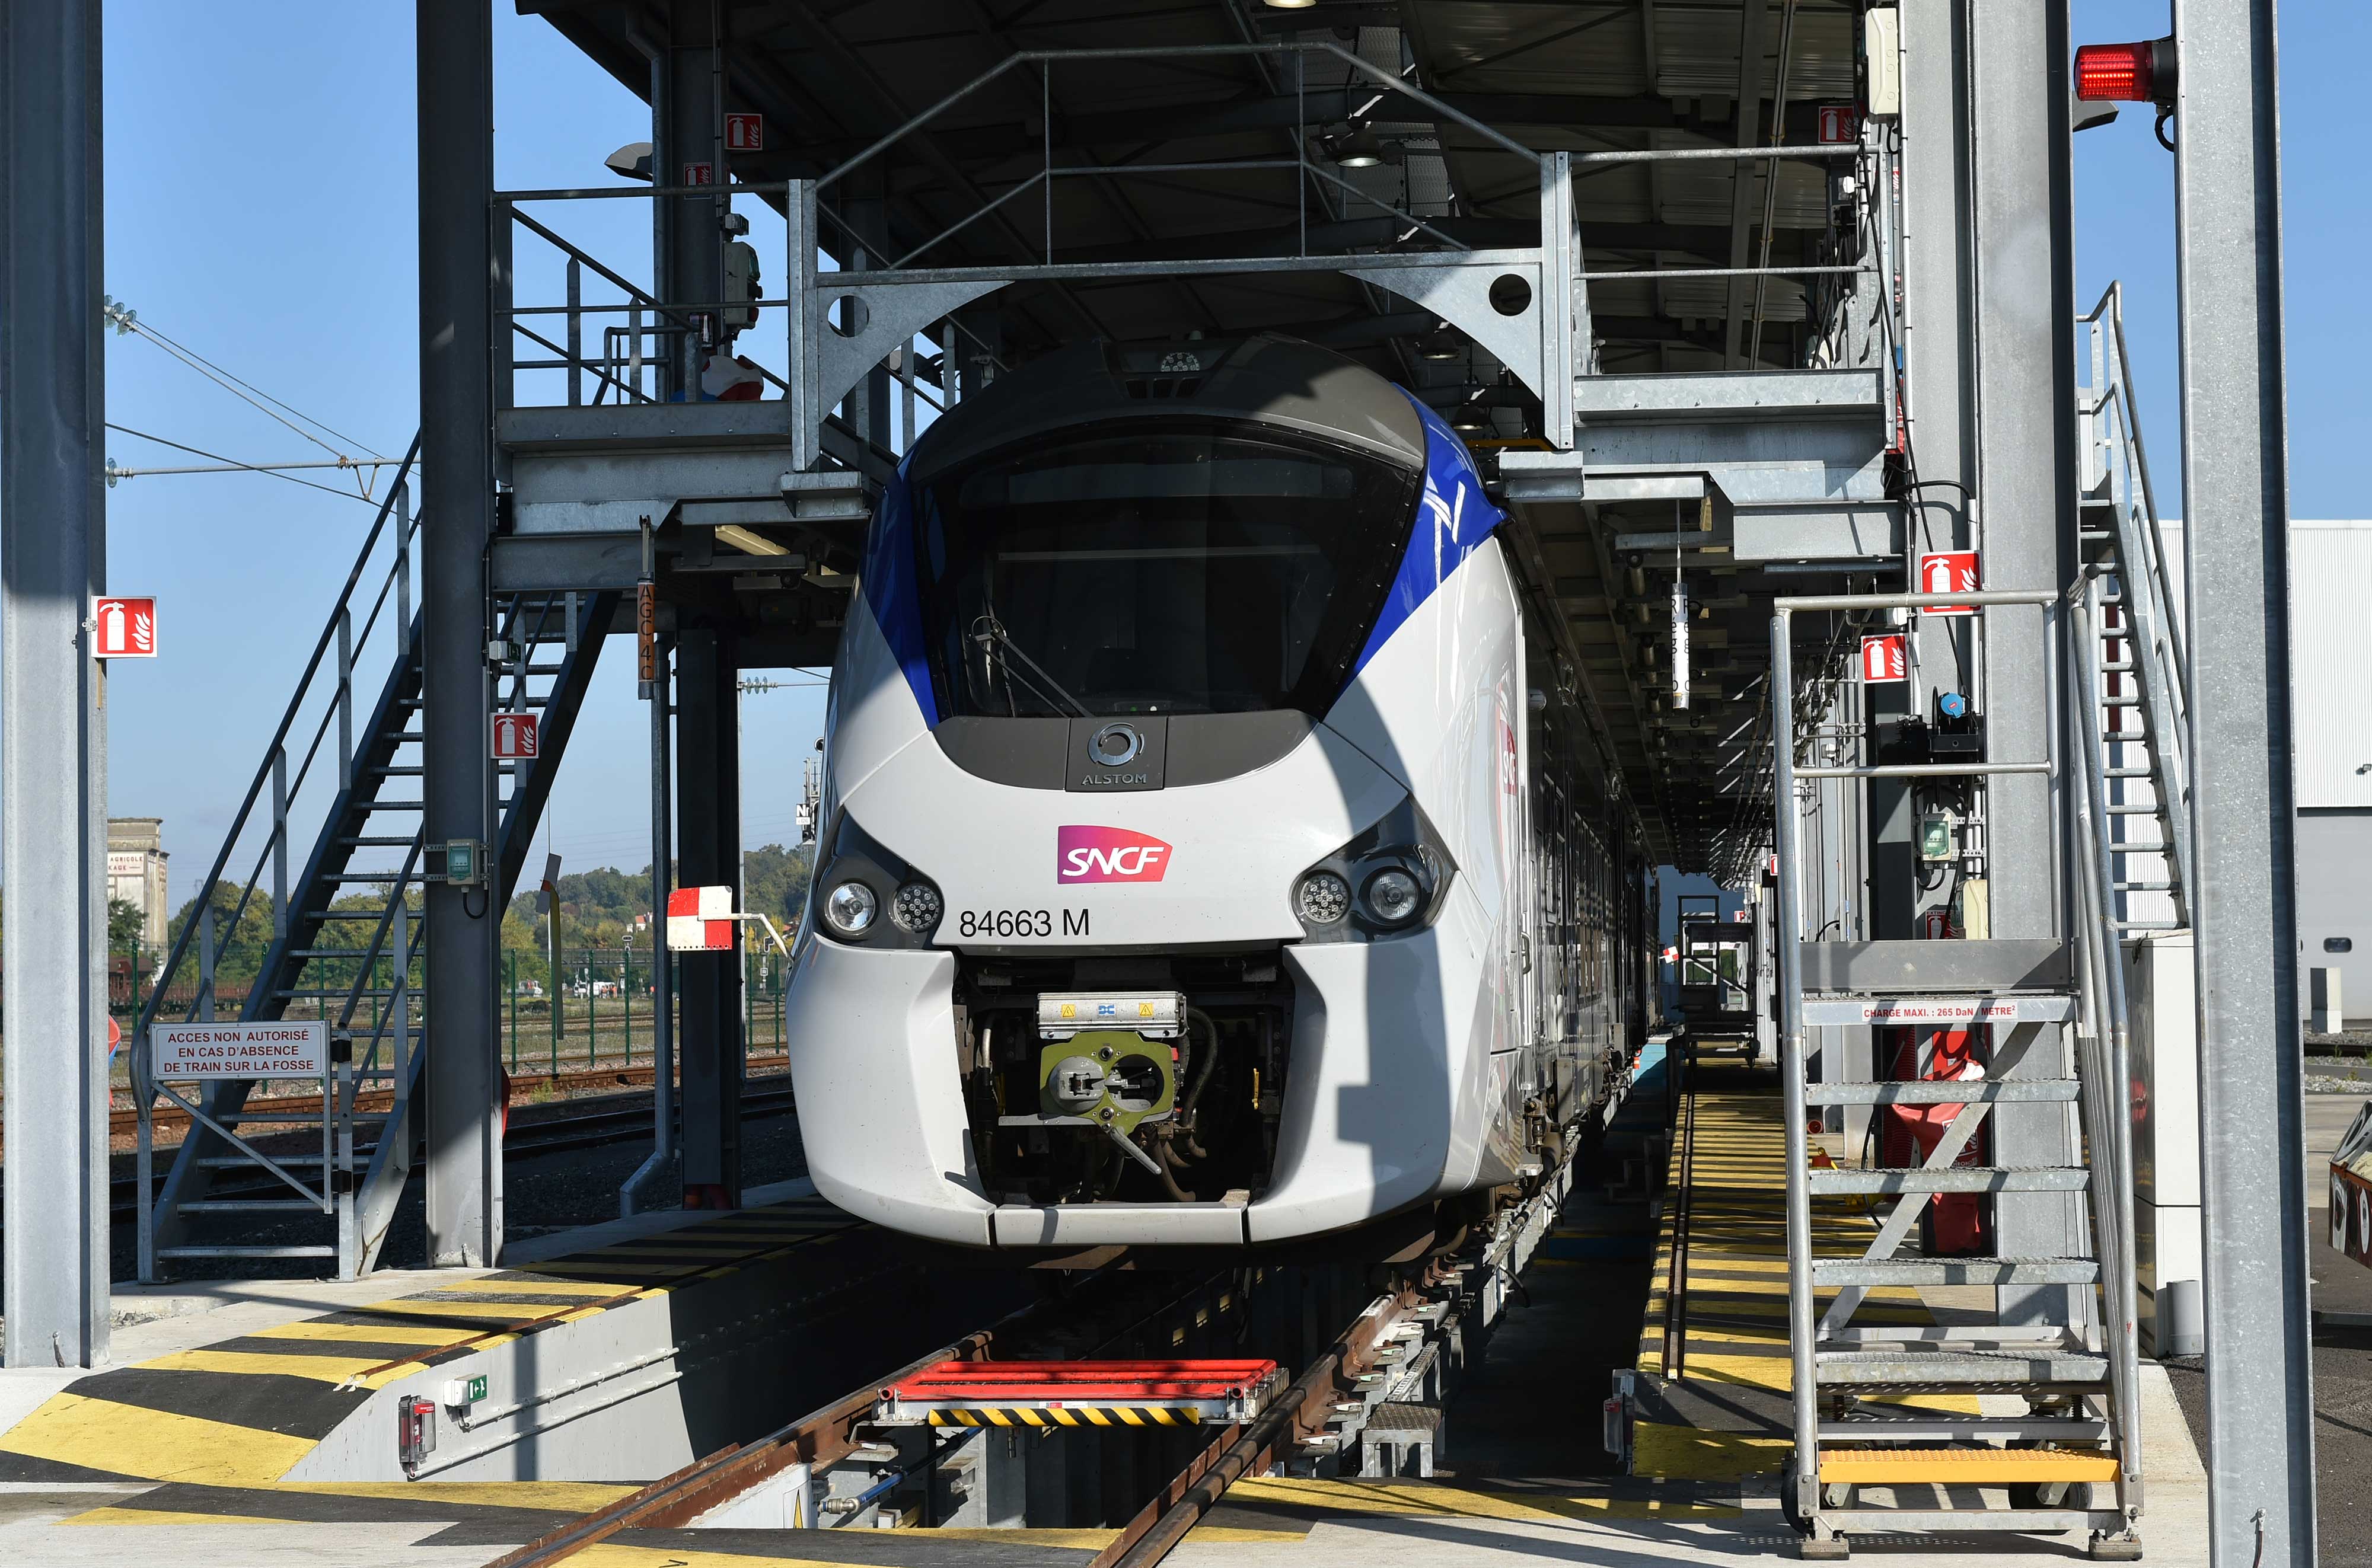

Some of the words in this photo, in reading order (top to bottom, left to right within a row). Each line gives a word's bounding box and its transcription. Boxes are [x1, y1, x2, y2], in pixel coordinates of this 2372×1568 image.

[640, 586, 652, 635] AGC
[640, 645, 651, 680] 4C
[1082, 774, 1147, 785] ALSTOM
[1062, 847, 1164, 877] SNCF
[959, 910, 1052, 937] 84663
[1063, 909, 1089, 936] M
[1864, 1009, 1901, 1017] CHARGE
[1904, 1008, 1928, 1017] MAXI.
[1937, 1008, 1953, 1016] 265
[1956, 1008, 1974, 1016] DaN
[168, 1033, 210, 1043] ACCES
[214, 1032, 240, 1042] NON
[247, 1029, 309, 1041] AUTORISÉ
[178, 1048, 195, 1057] EN
[199, 1047, 224, 1057] CAS
[228, 1046, 299, 1056] D'ABSENCE
[164, 1062, 180, 1072] DE
[184, 1062, 221, 1072] TRAIN
[225, 1061, 250, 1071] SUR
[254, 1061, 270, 1071] LA
[273, 1060, 314, 1070] FOSSE
